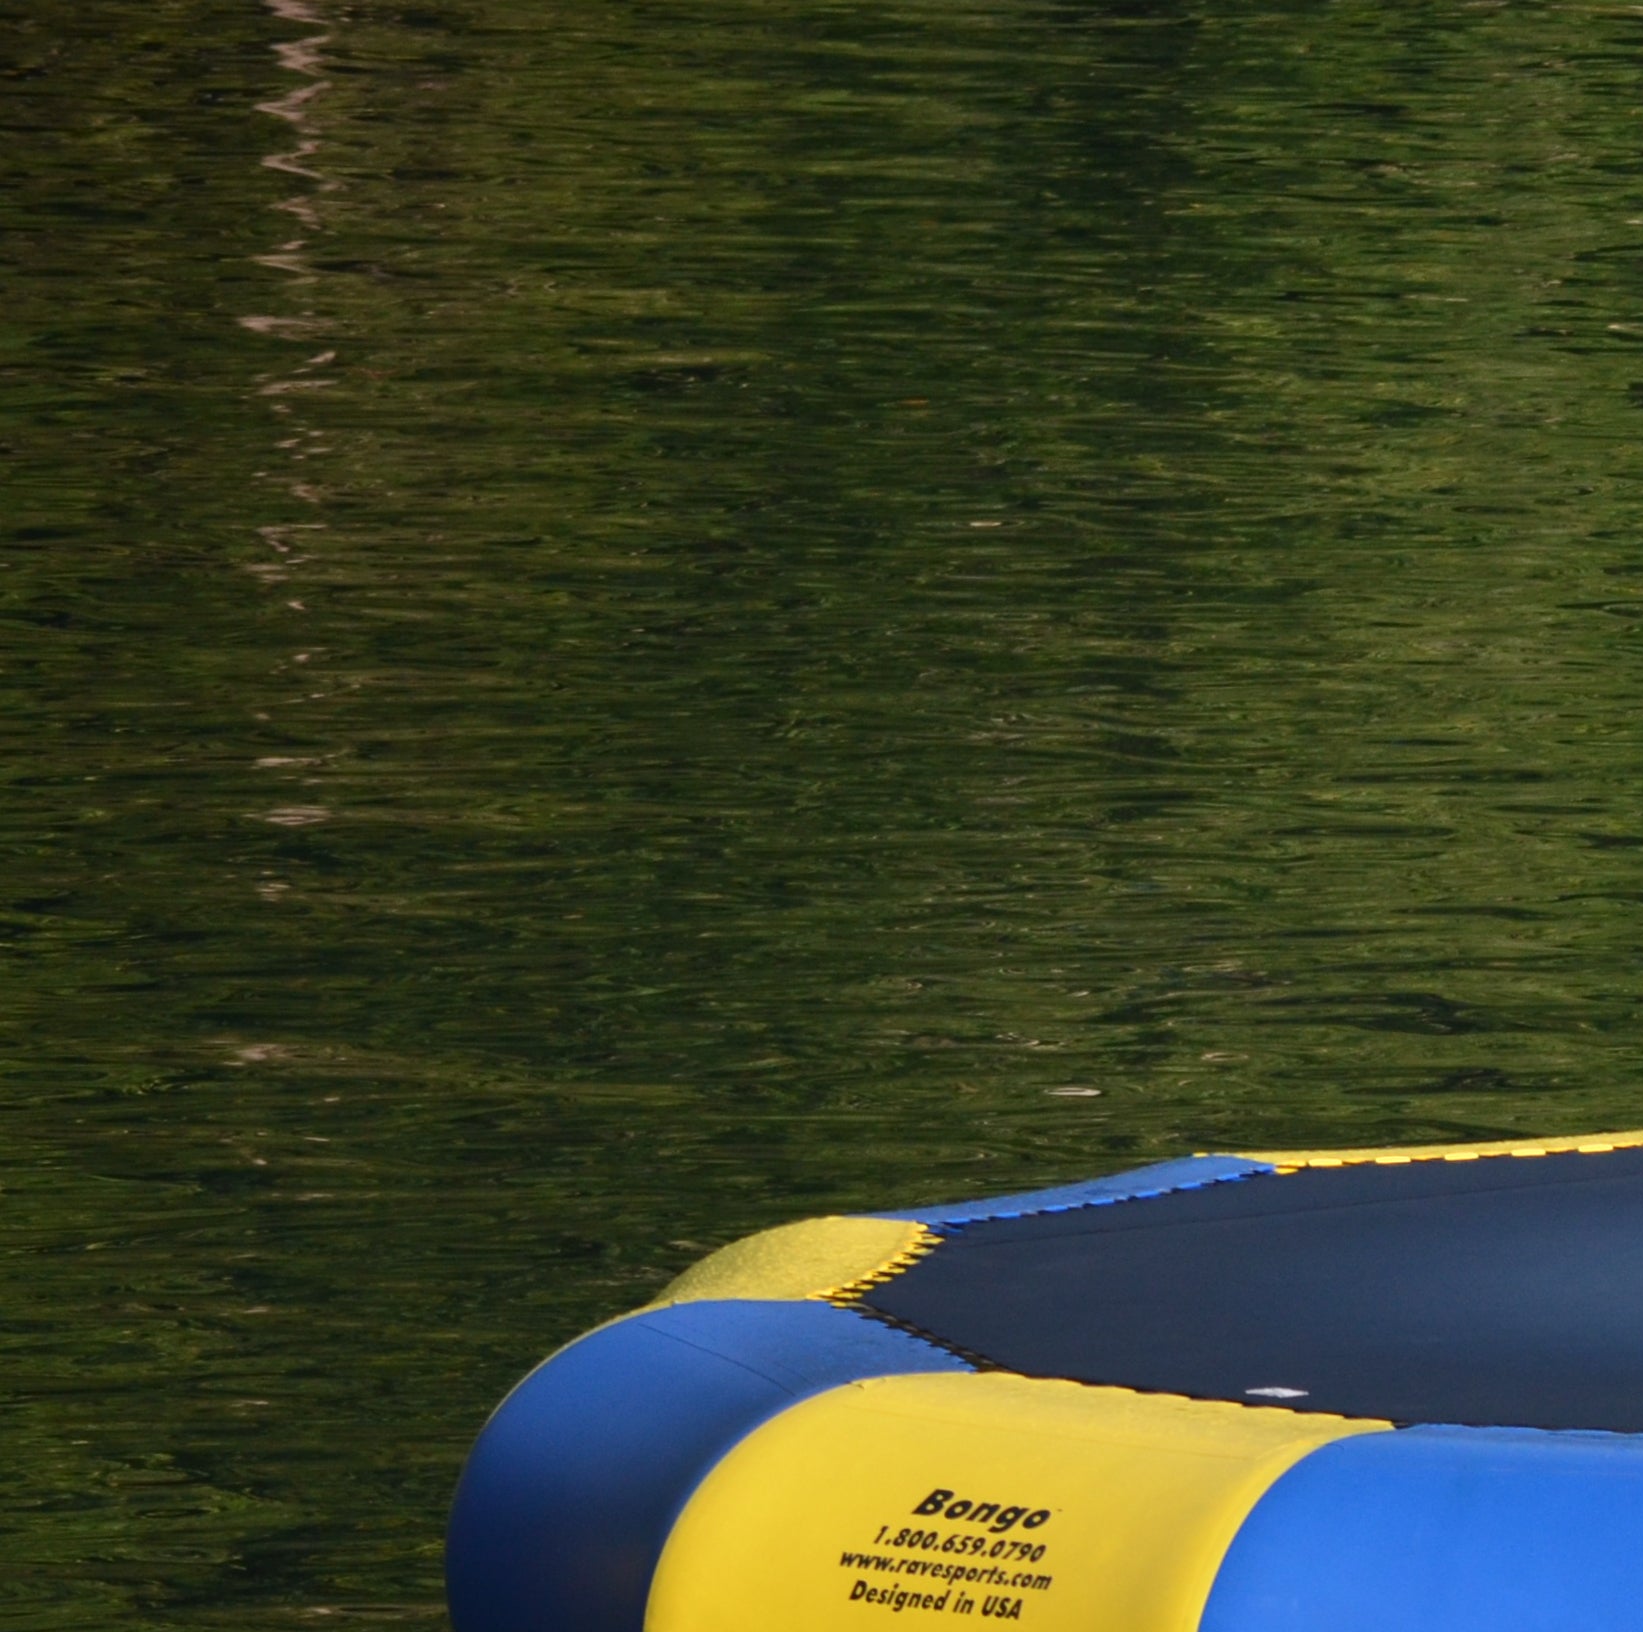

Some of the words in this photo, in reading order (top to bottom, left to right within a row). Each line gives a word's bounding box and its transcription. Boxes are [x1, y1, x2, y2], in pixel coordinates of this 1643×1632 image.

[911, 1488, 1051, 1533] Bongo
[873, 1525, 1047, 1563] 1.800.659.0790
[840, 1551, 1053, 1590] www.ravesports.com
[849, 1579, 951, 1612] Designed
[953, 1590, 974, 1614] in
[980, 1595, 1023, 1620] USA
